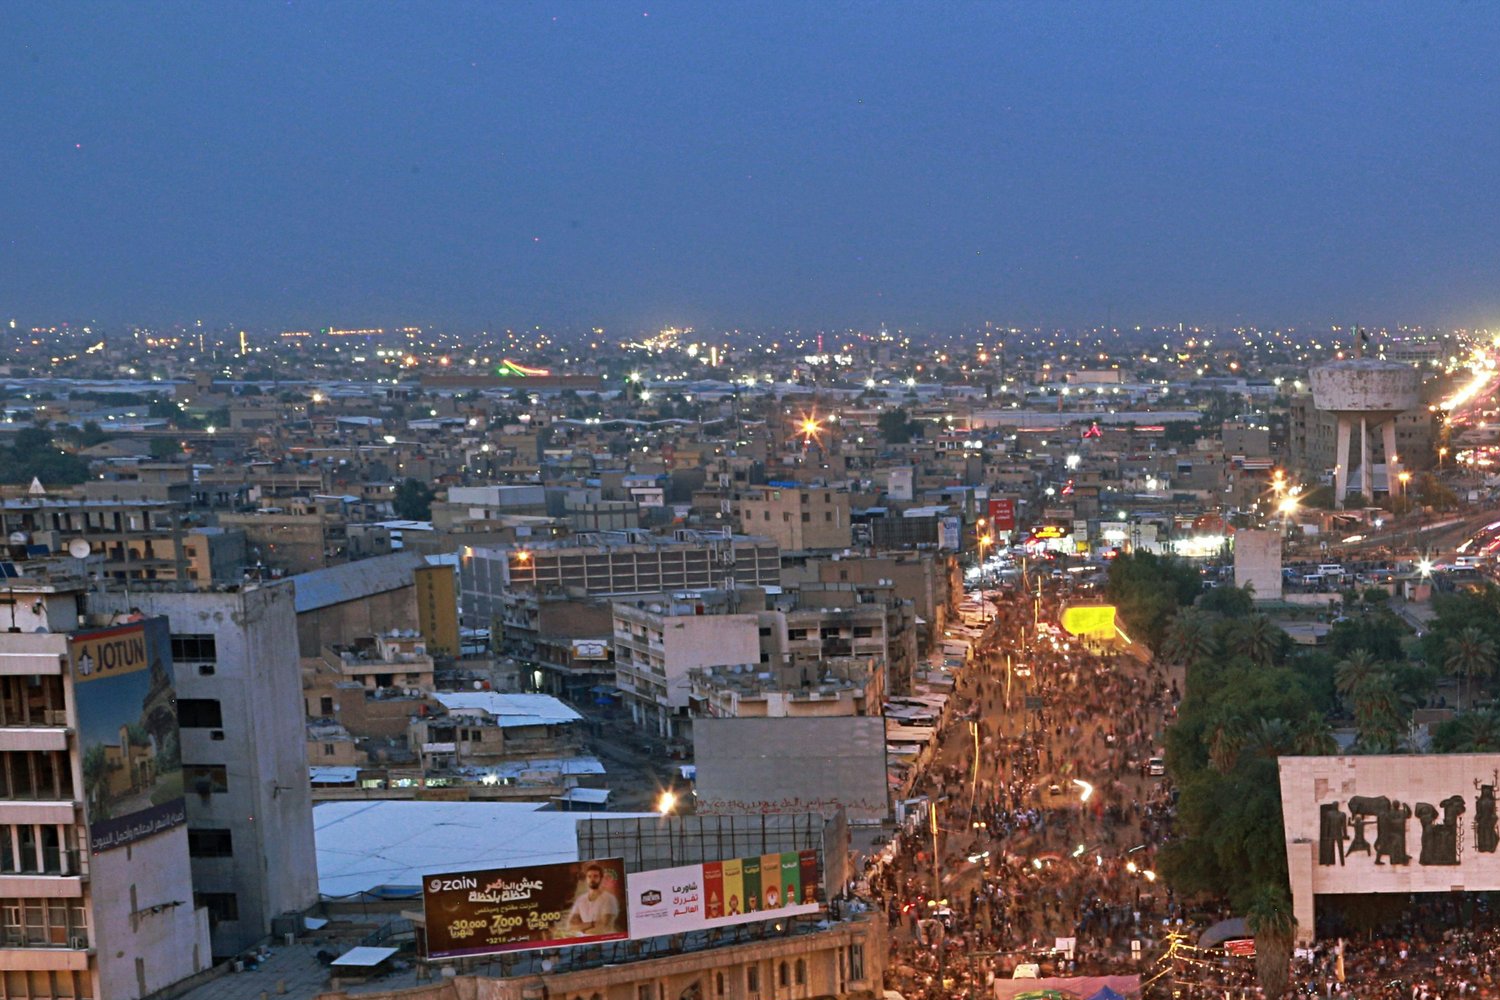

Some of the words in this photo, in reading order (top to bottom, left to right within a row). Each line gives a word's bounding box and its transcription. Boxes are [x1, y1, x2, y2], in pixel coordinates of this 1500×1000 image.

[96, 637, 145, 672] JOTUN
[672, 881, 698, 894] شاورما
[468, 890, 501, 903] بلحظة
[502, 889, 531, 902] لحظة
